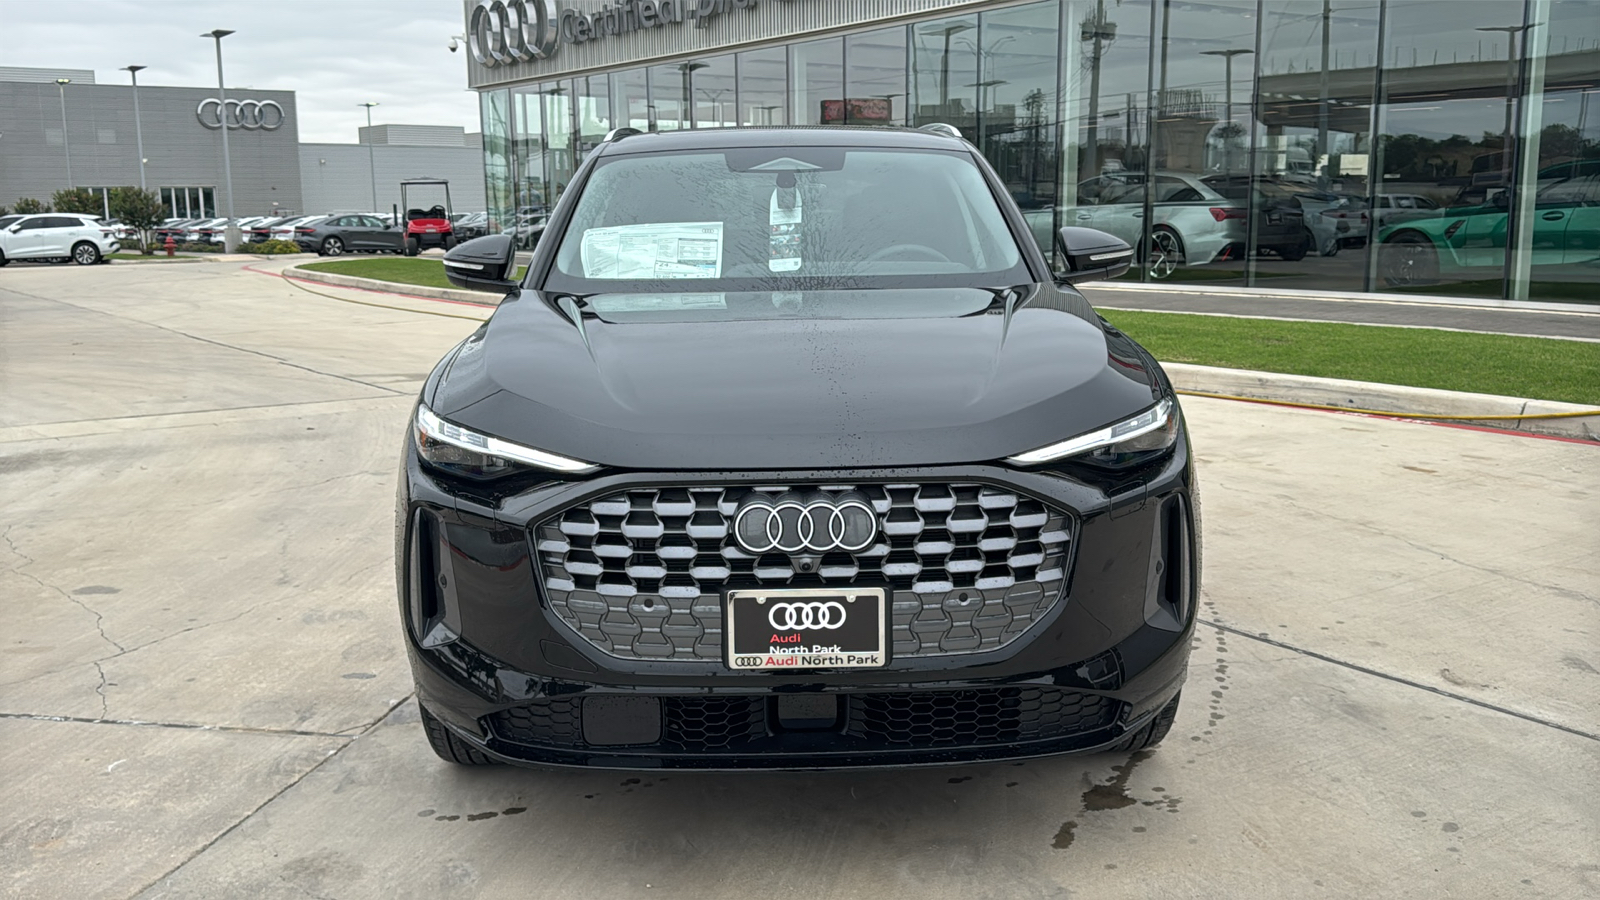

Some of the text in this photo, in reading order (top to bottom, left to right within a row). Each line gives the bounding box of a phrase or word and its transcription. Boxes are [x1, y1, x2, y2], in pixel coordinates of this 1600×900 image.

[561, 0, 683, 44] Certified
[770, 633, 801, 644] Audi
[769, 644, 841, 654] North Park
[765, 655, 879, 666] Audi North Park
